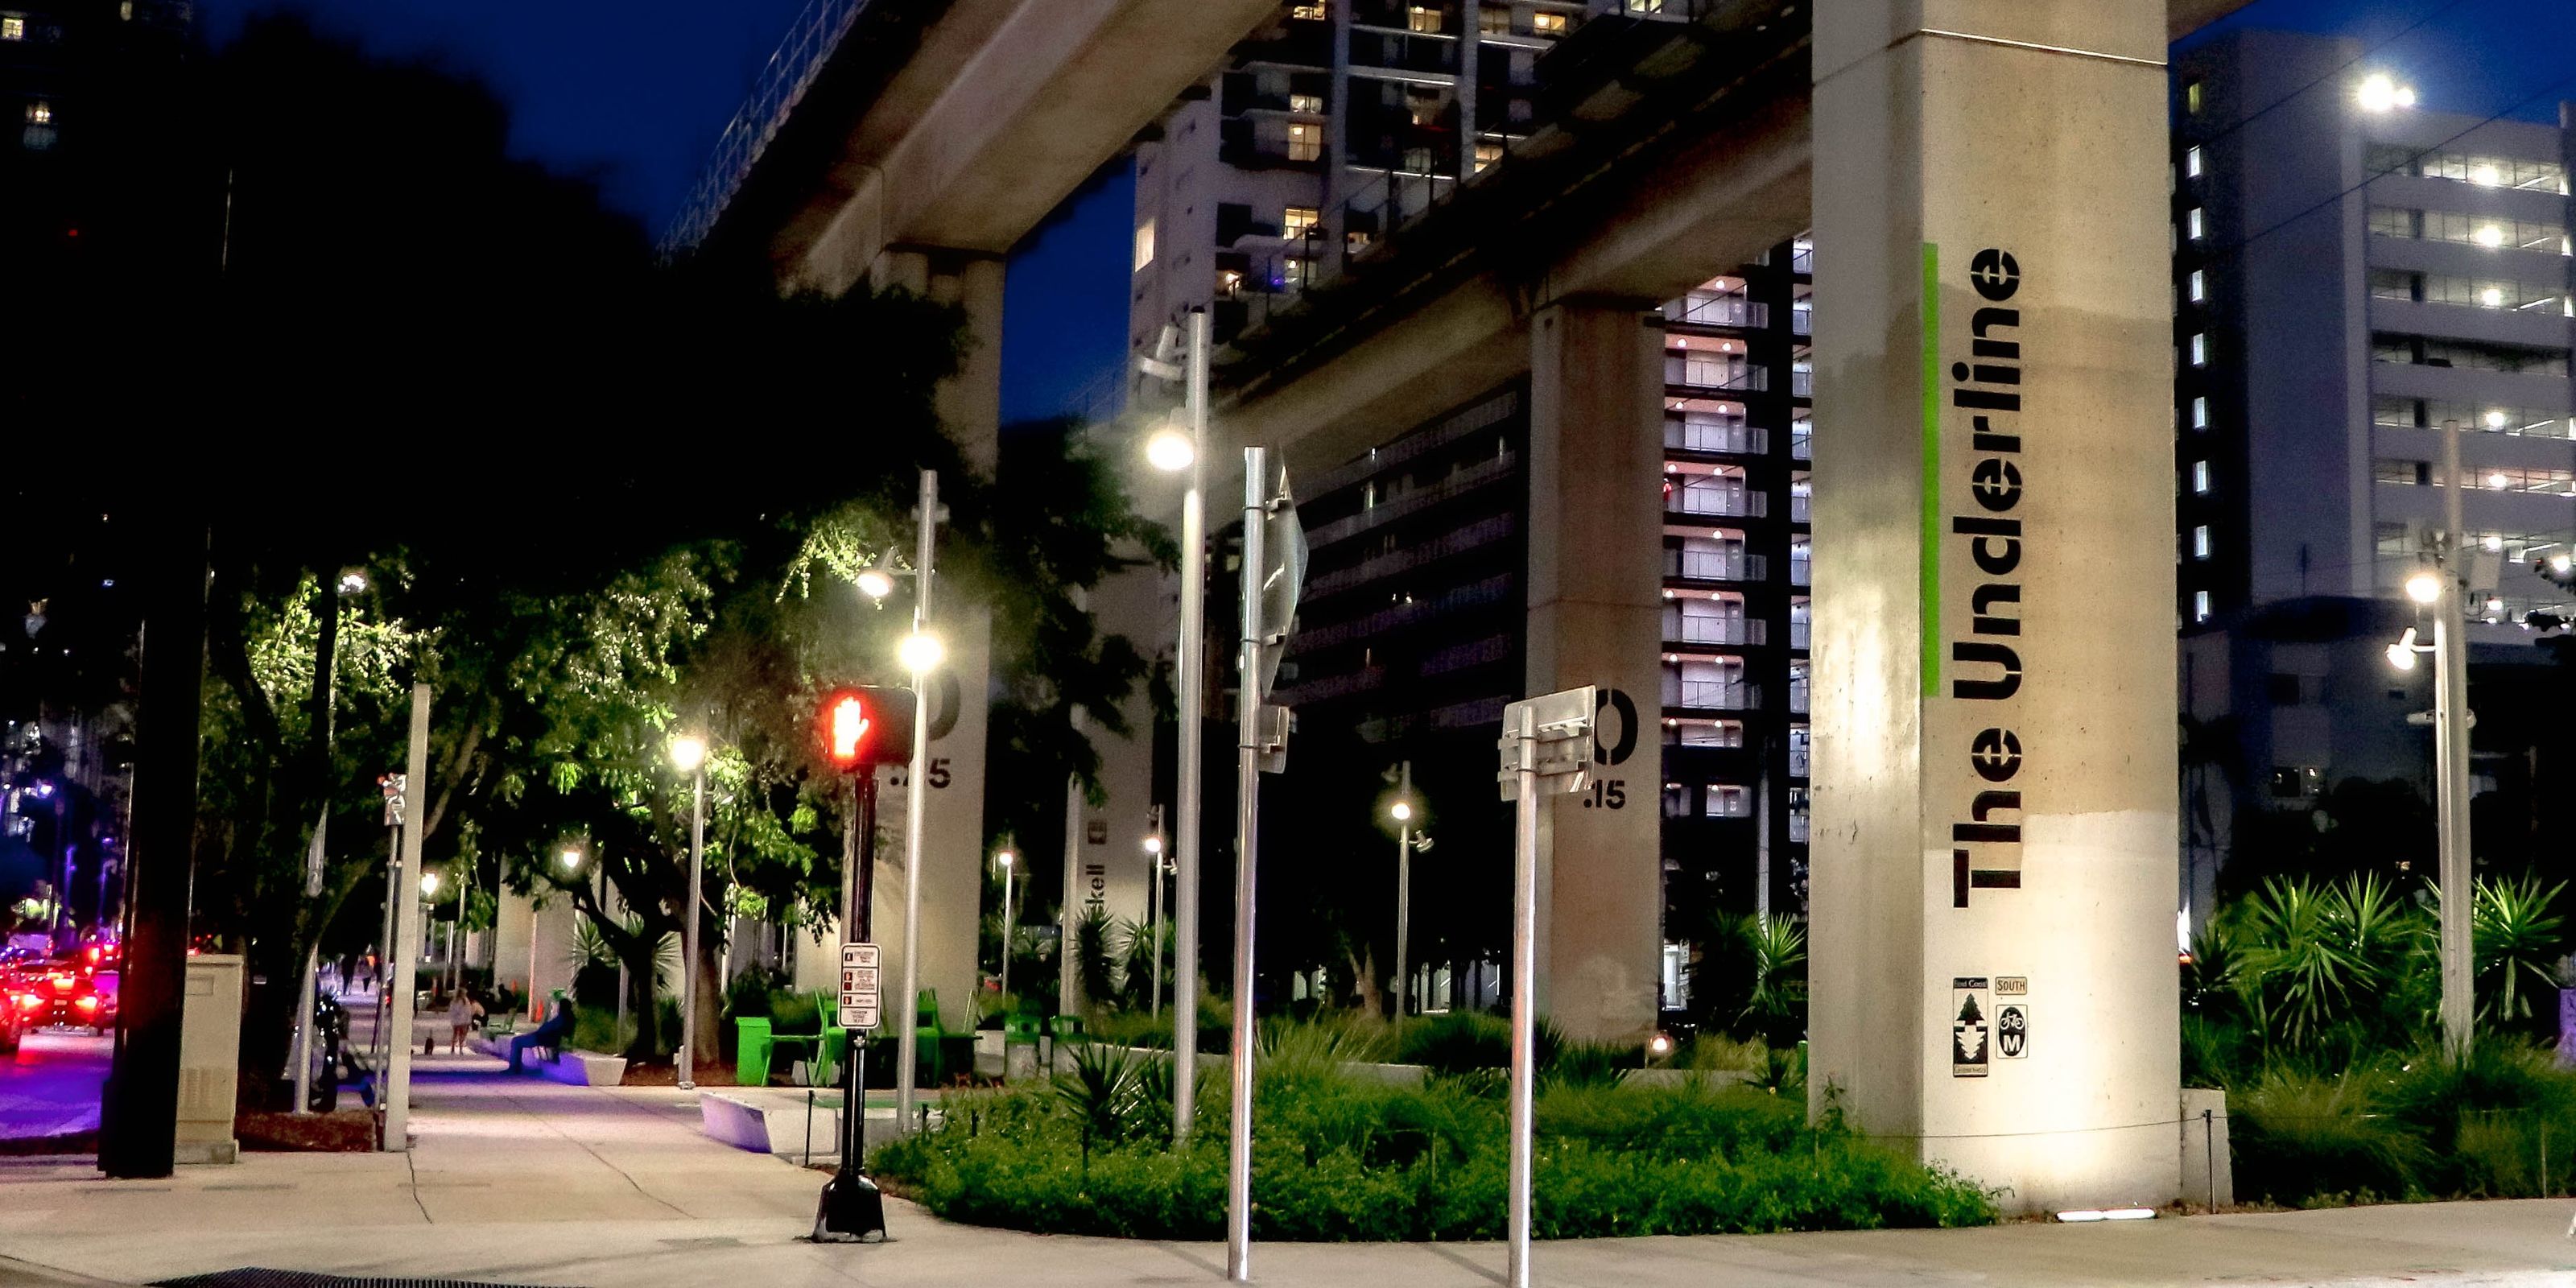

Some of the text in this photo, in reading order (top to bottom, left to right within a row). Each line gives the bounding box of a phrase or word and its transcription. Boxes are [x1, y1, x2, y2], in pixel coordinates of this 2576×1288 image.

[1952, 248, 2022, 908] The Underline
[1583, 779, 1626, 810] .15
[1997, 980, 2025, 991] SOUTH
[2003, 1034, 2021, 1052] M
